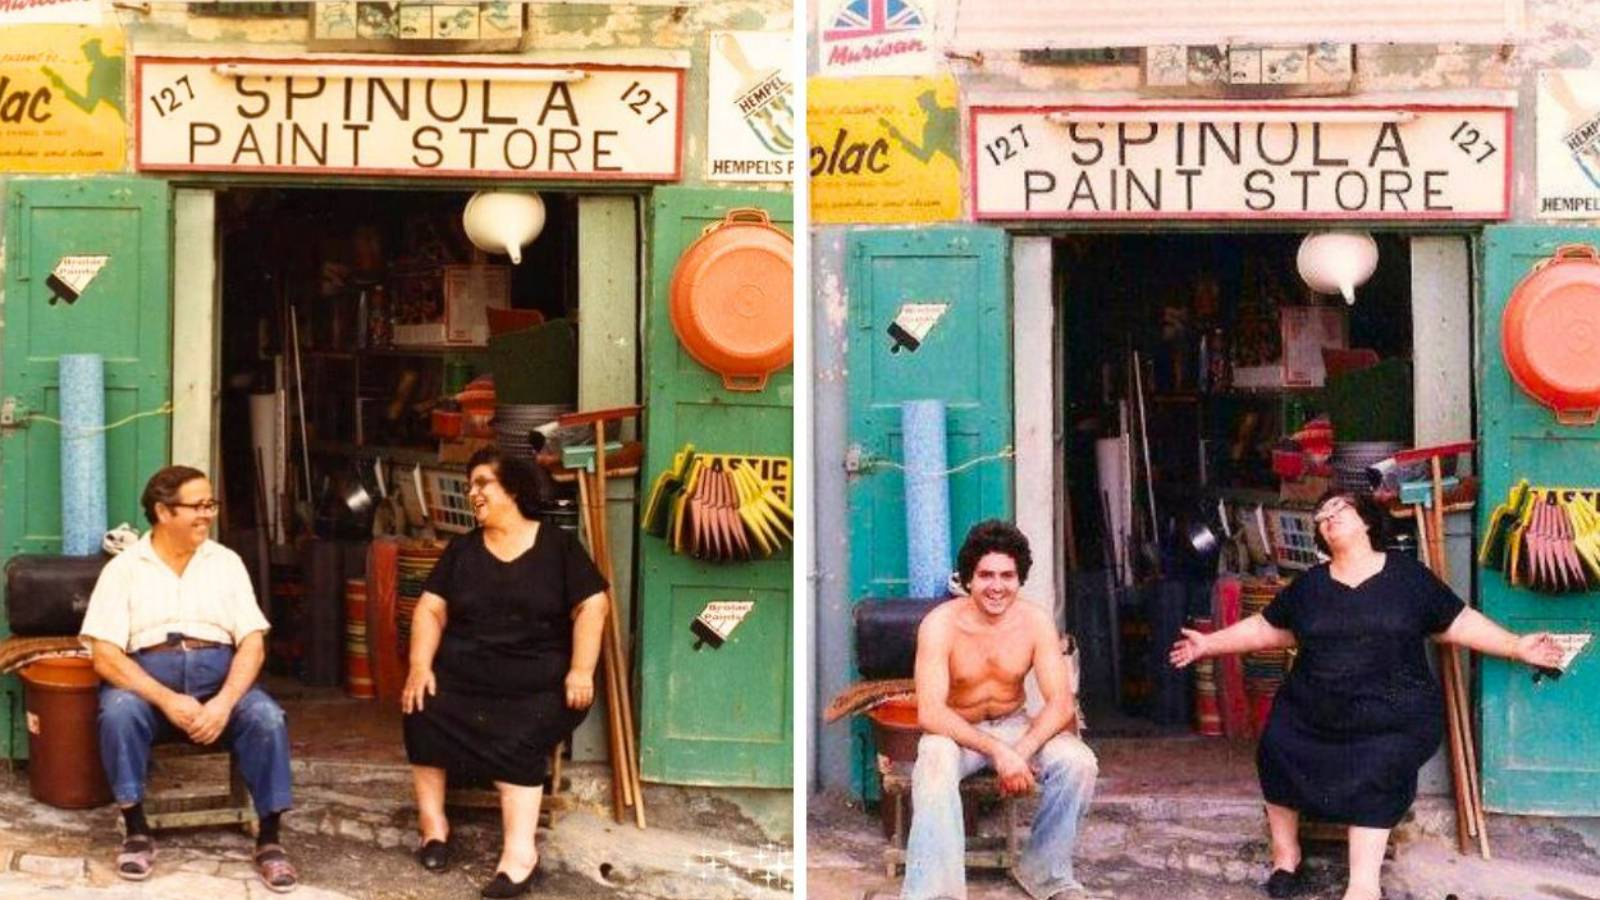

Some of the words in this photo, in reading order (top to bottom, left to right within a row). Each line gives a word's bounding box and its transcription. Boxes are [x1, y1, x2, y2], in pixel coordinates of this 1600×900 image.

[150, 74, 196, 117] 127
[235, 77, 580, 126] SPINOLA
[620, 81, 669, 126] 127
[738, 76, 786, 113] HEMPEL
[188, 122, 371, 166] PAINT
[412, 126, 623, 171] STORE
[985, 124, 1032, 166] 127
[1069, 121, 1410, 168] SPINOLA
[1449, 121, 1497, 165] 127
[712, 159, 783, 175] HEMPEL'S
[1024, 170, 1203, 212] PAINT
[1243, 170, 1453, 212] STORE
